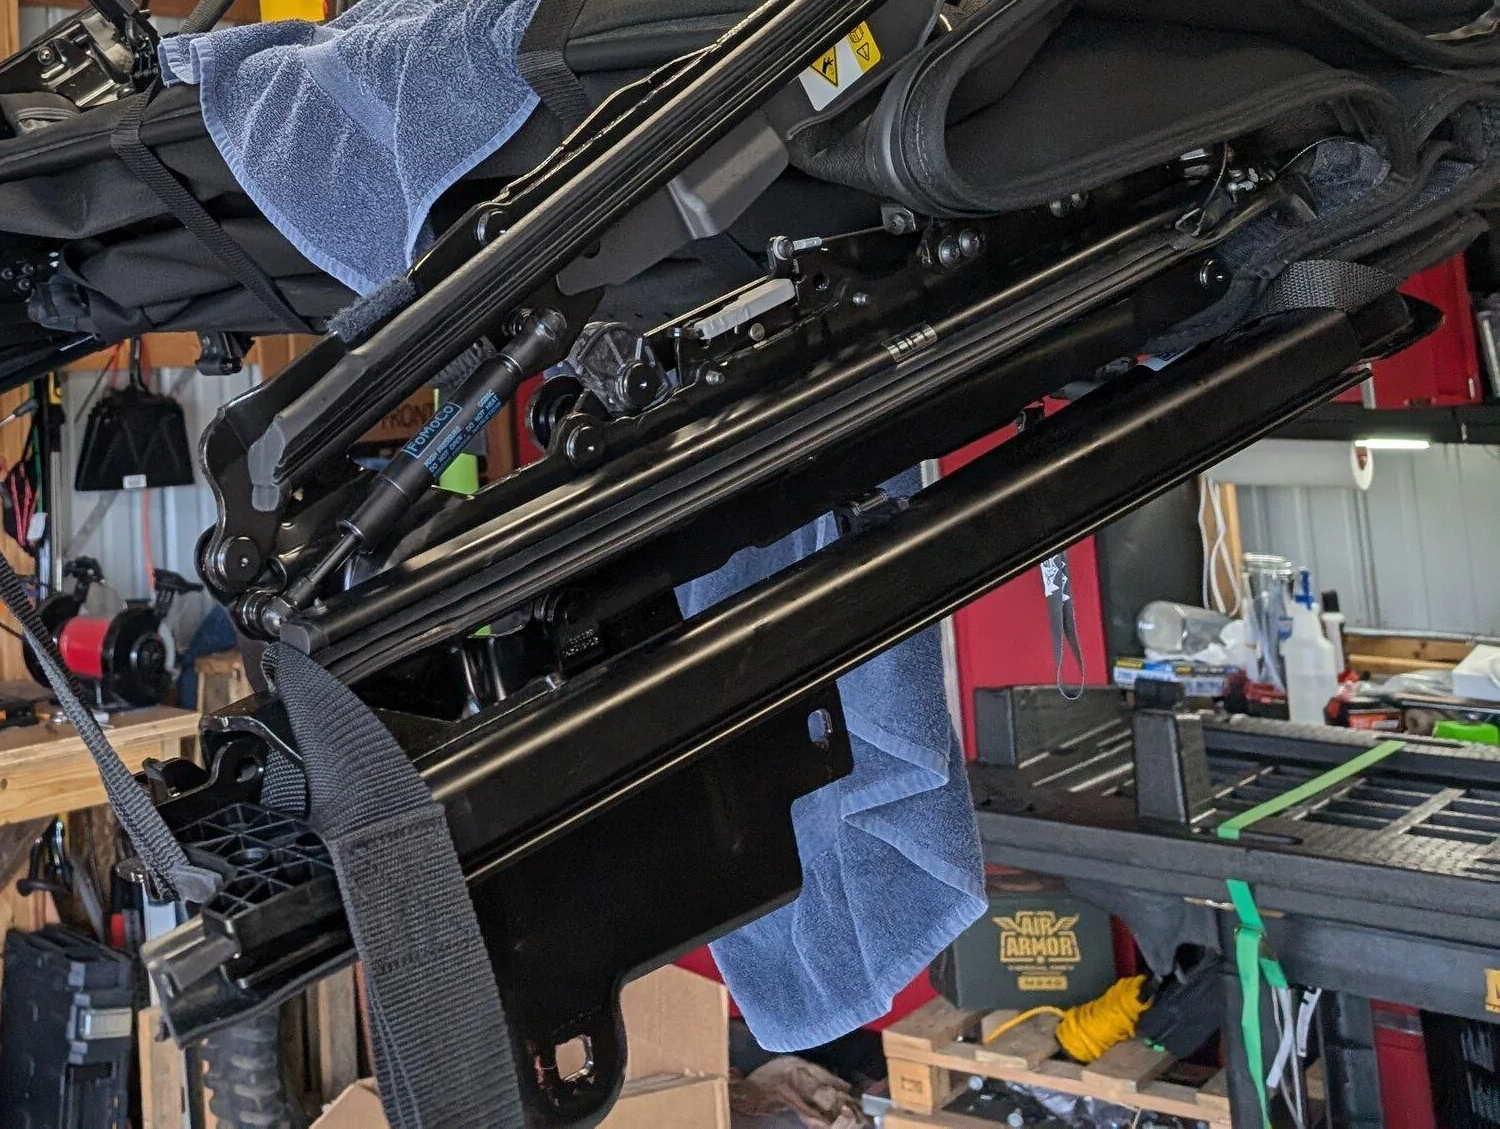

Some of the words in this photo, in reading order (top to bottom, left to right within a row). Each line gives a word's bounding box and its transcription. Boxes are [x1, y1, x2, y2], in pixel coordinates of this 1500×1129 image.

[406, 405, 455, 452] FoMoCo
[1020, 915, 1054, 936] AIR
[1006, 936, 1075, 956] ARMOR
